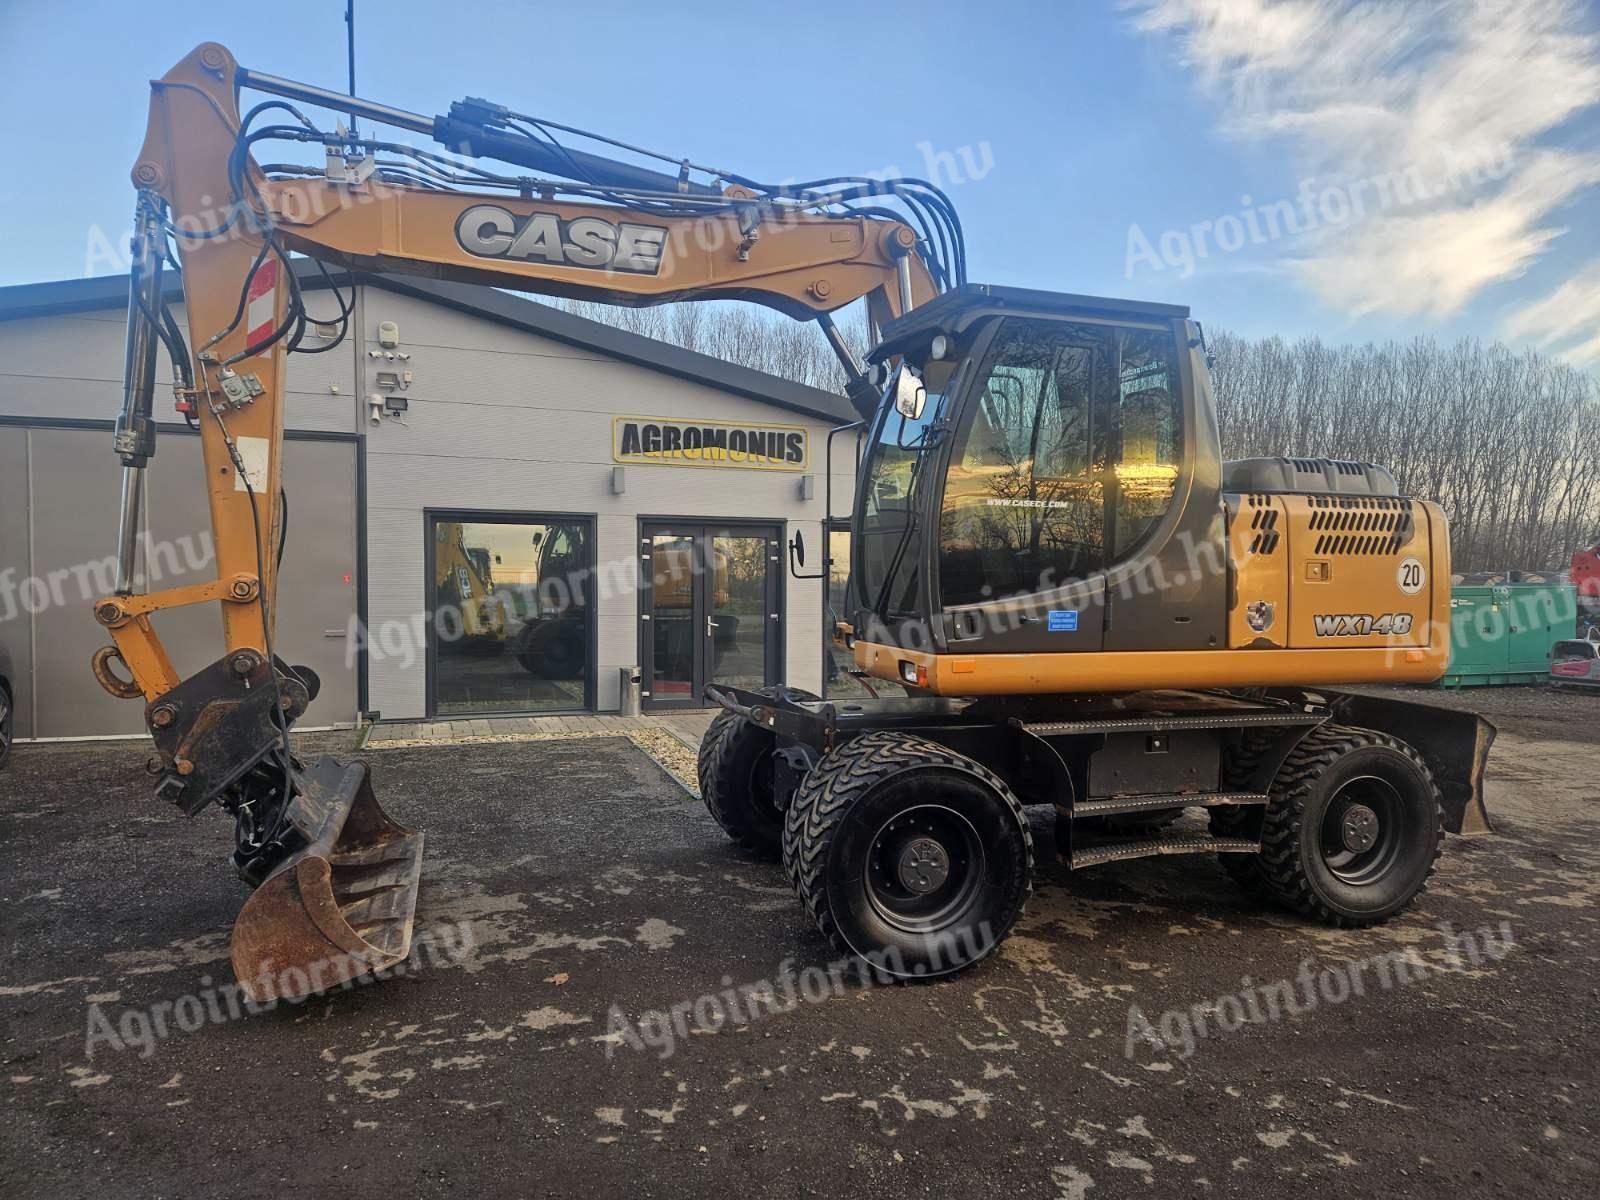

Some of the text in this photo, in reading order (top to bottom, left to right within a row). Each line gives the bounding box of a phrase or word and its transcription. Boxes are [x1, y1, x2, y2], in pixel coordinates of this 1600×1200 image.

[457, 204, 667, 273] CASE
[621, 424, 803, 463] AGROMONUS
[1402, 564, 1420, 587] 20
[1314, 614, 1413, 636] WX148
